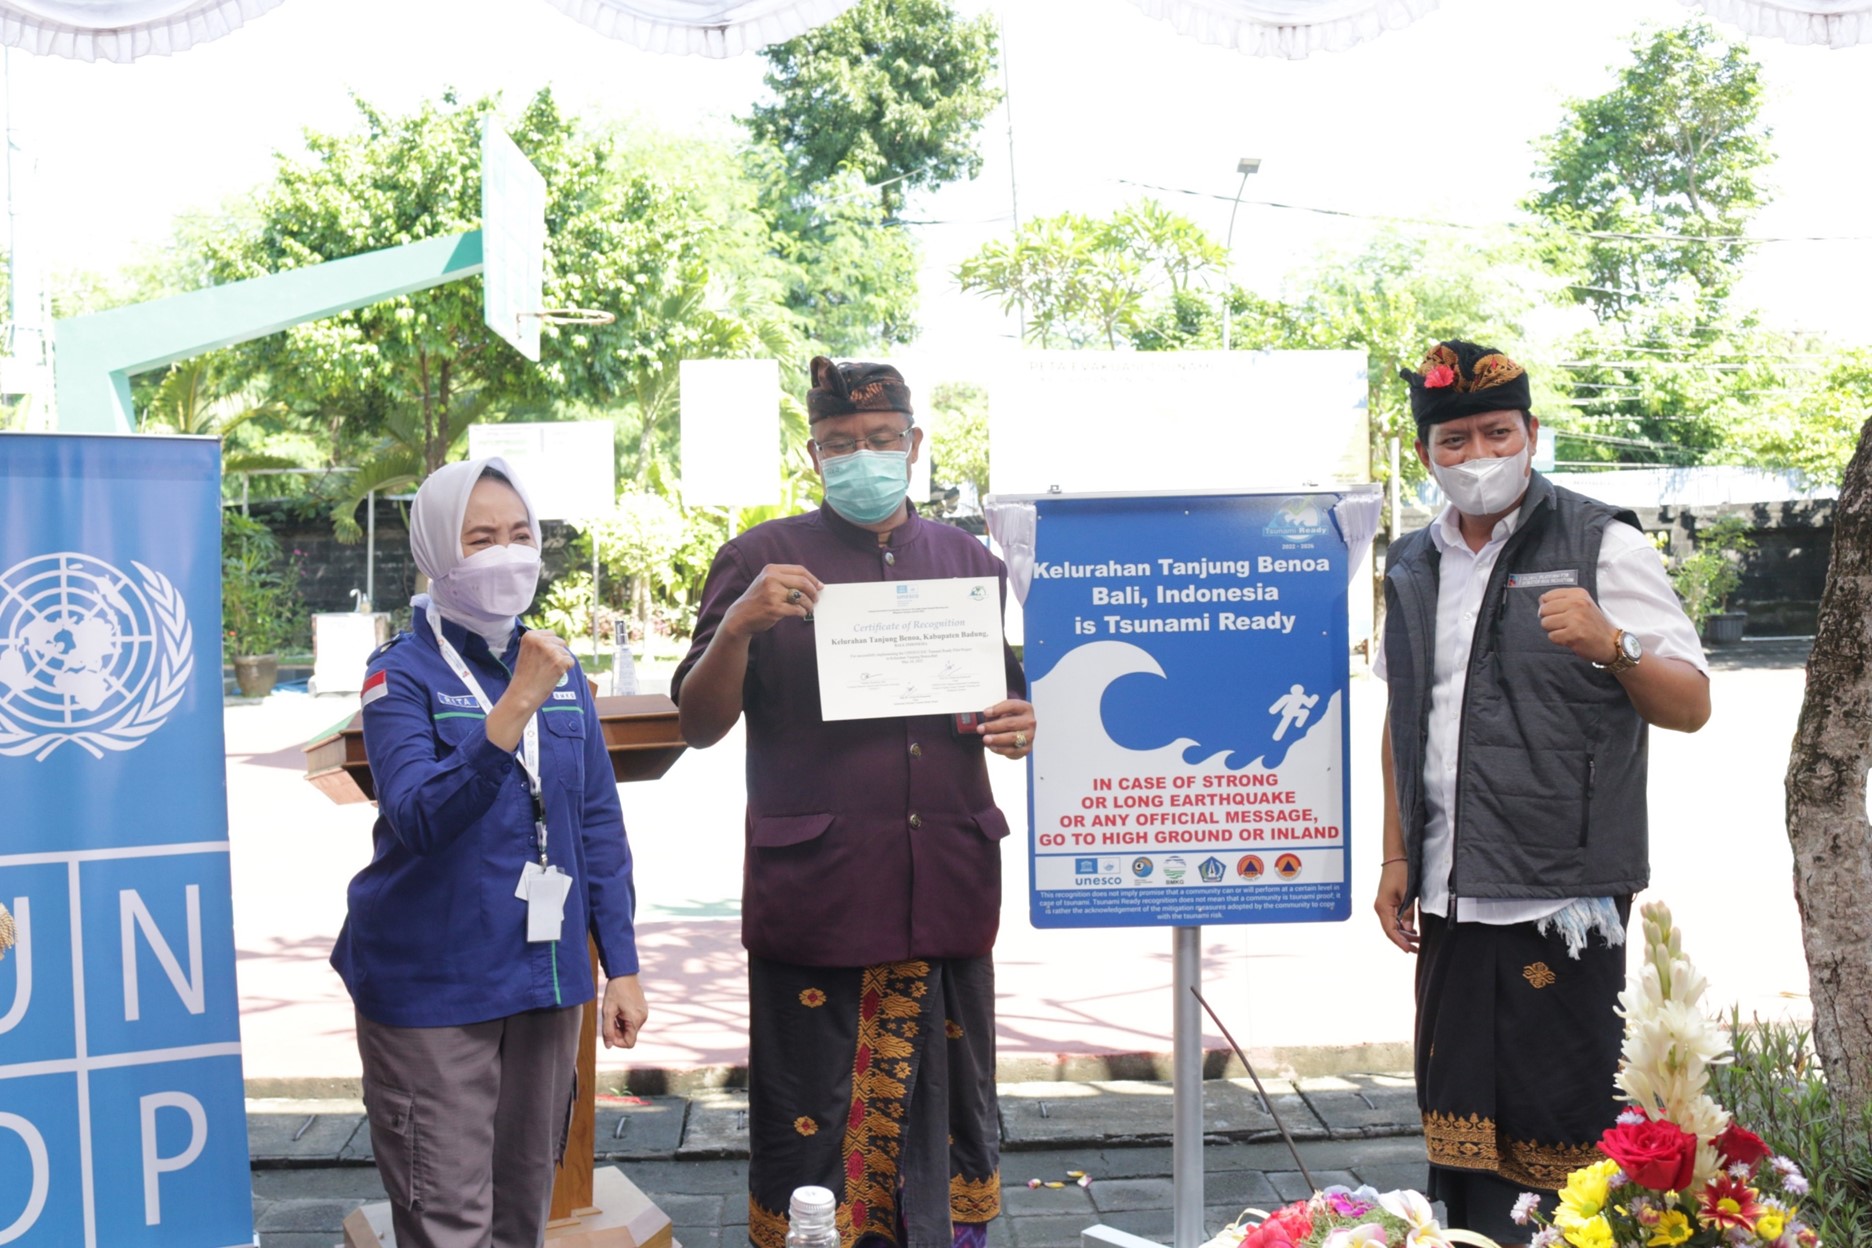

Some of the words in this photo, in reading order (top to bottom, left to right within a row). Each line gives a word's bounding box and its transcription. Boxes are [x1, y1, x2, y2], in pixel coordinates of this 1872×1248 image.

[1034, 561, 1151, 579] Kelurahan
[1158, 558, 1250, 578] Tanjung
[1258, 556, 1330, 572] Benoa
[1092, 586, 1148, 608] Bali,
[1157, 583, 1279, 603] Indonesia
[854, 623, 899, 632] Certificate
[902, 622, 911, 632] of
[914, 619, 965, 629] Recognition
[1075, 617, 1096, 634] is
[1104, 612, 1209, 633] Tsunami
[1219, 612, 1295, 633] Ready
[869, 636, 897, 644] Tanjung
[924, 632, 960, 641] Kabupaten
[961, 631, 989, 639] Badung,
[1093, 778, 1111, 791] IN
[1119, 776, 1166, 790] CASE
[1173, 776, 1196, 789] OF
[1202, 773, 1278, 788] STRONG
[1082, 796, 1107, 809] OR
[1114, 794, 1163, 808] LONG
[1170, 792, 1296, 806] EARTHQUAKE
[1060, 815, 1085, 828] OR
[1092, 813, 1129, 827] ANY
[1136, 811, 1219, 826] OFFICIAL
[1226, 809, 1318, 824] MESSAGE,
[1039, 833, 1065, 847] GO
[1072, 832, 1096, 846] TO
[1102, 832, 1148, 845] HIGH
[1155, 829, 1233, 844] GROUND
[1239, 828, 1264, 841] OR
[1271, 826, 1339, 840] INLAND
[1075, 877, 1121, 885] unesco
[1056, 891, 1090, 899] recognition
[1186, 888, 1220, 896] community
[1256, 886, 1279, 894] perform
[1246, 894, 1281, 902] community
